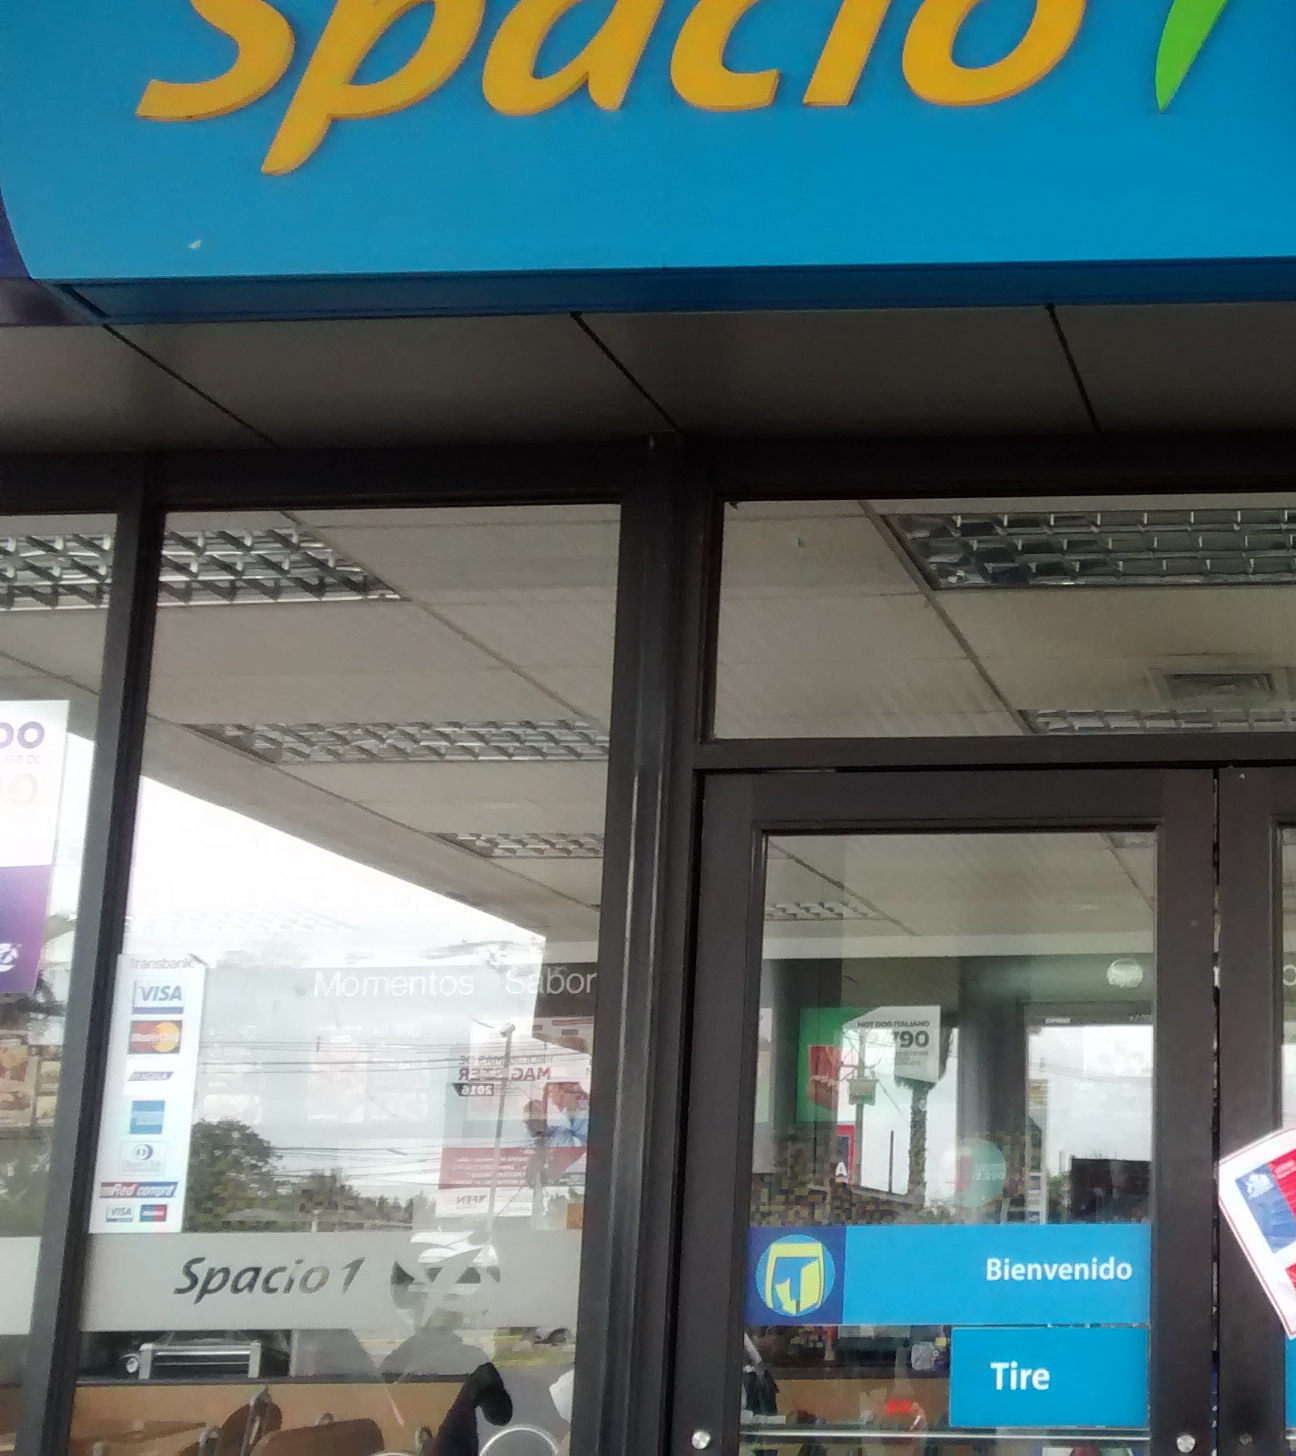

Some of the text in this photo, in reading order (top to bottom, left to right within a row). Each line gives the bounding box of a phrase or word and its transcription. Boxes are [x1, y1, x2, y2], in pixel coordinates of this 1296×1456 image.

[139, 985, 182, 1001] VISA
[313, 967, 598, 998] Momentos Sabor
[111, 1207, 132, 1216] VISA
[173, 1256, 366, 1305] Spacio 1
[985, 1256, 1133, 1282] Bienvenido
[990, 1360, 1051, 1391] Tire
